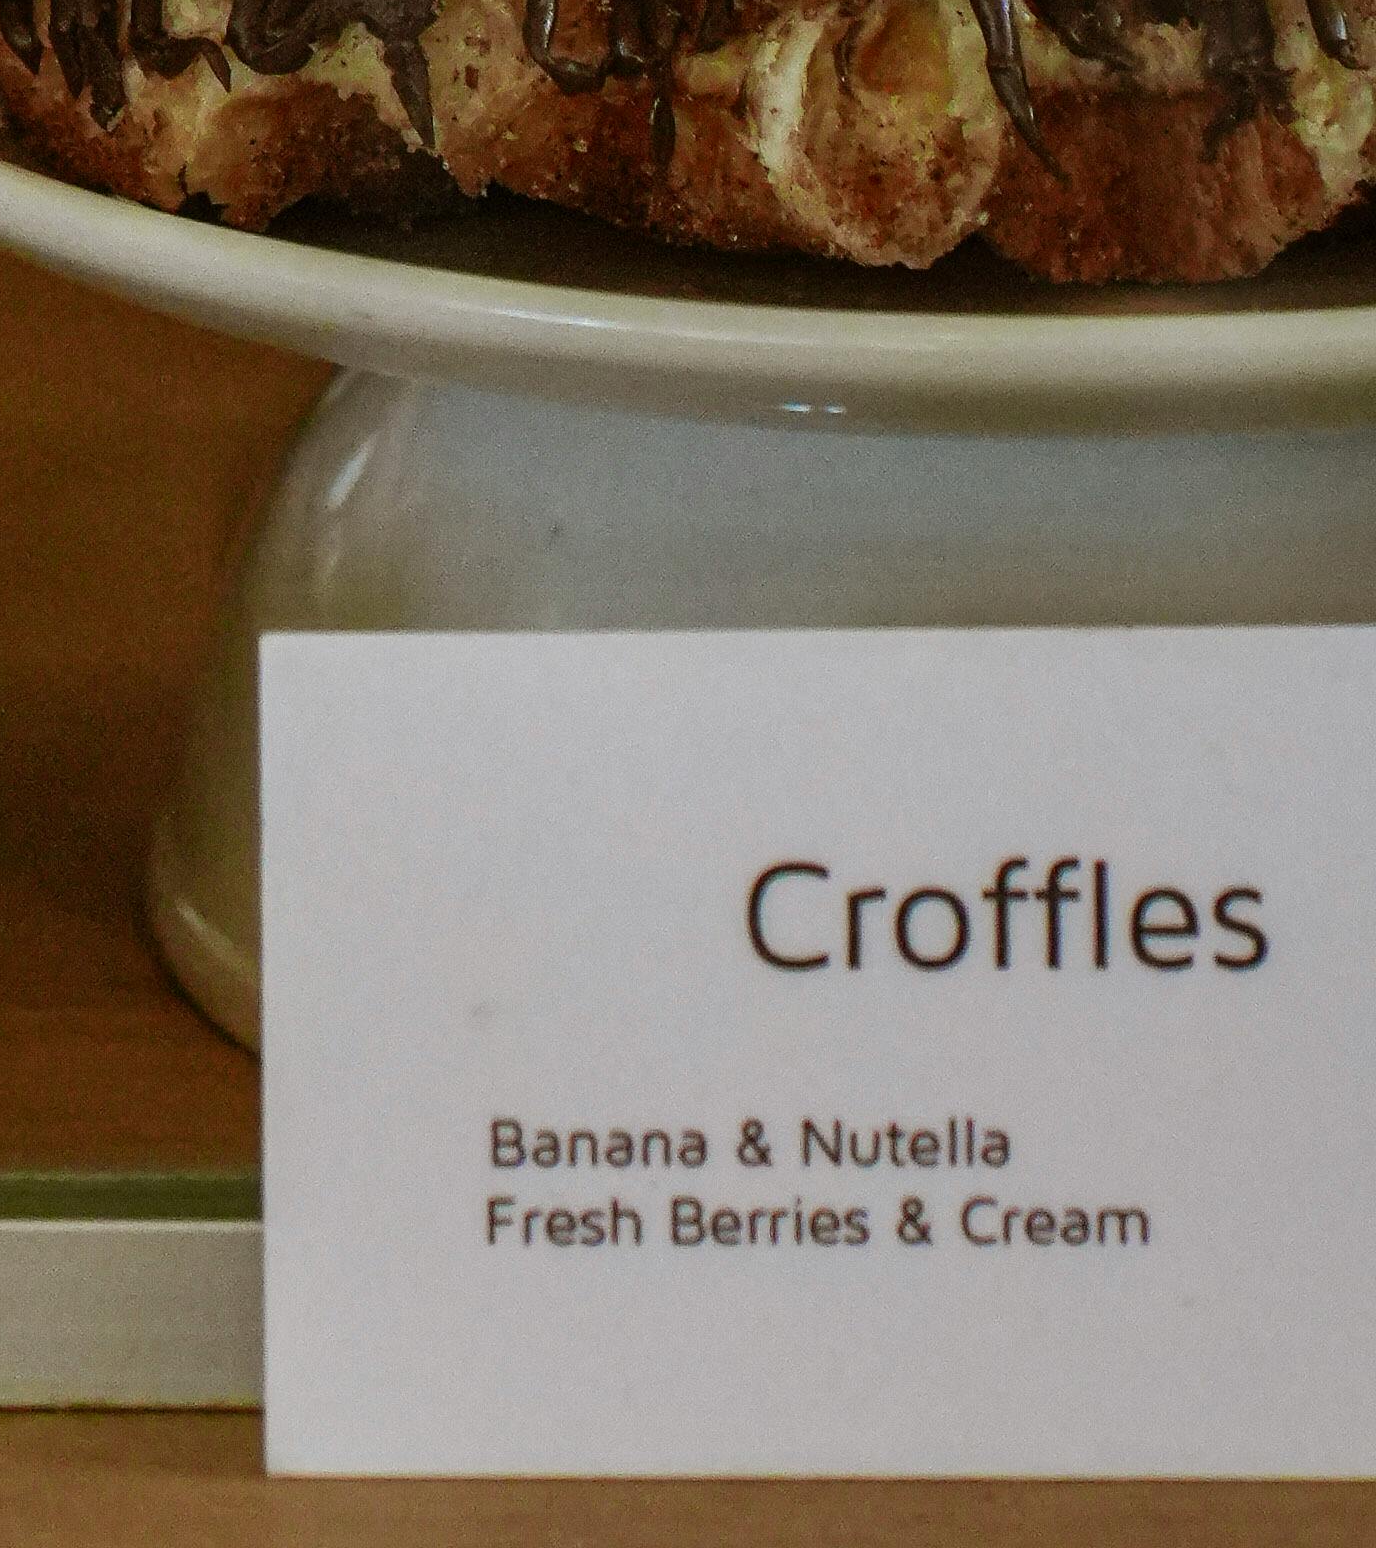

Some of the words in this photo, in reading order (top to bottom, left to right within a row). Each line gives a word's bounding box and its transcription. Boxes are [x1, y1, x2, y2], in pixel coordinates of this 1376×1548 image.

[744, 854, 1271, 975] Croffles
[489, 1117, 709, 1170] Banana
[735, 1117, 774, 1169] &
[800, 1116, 1012, 1170] Nutella
[486, 1195, 644, 1248] Fresh
[669, 1195, 871, 1248] Berries
[895, 1195, 934, 1248] &
[959, 1194, 1151, 1248] Cream
